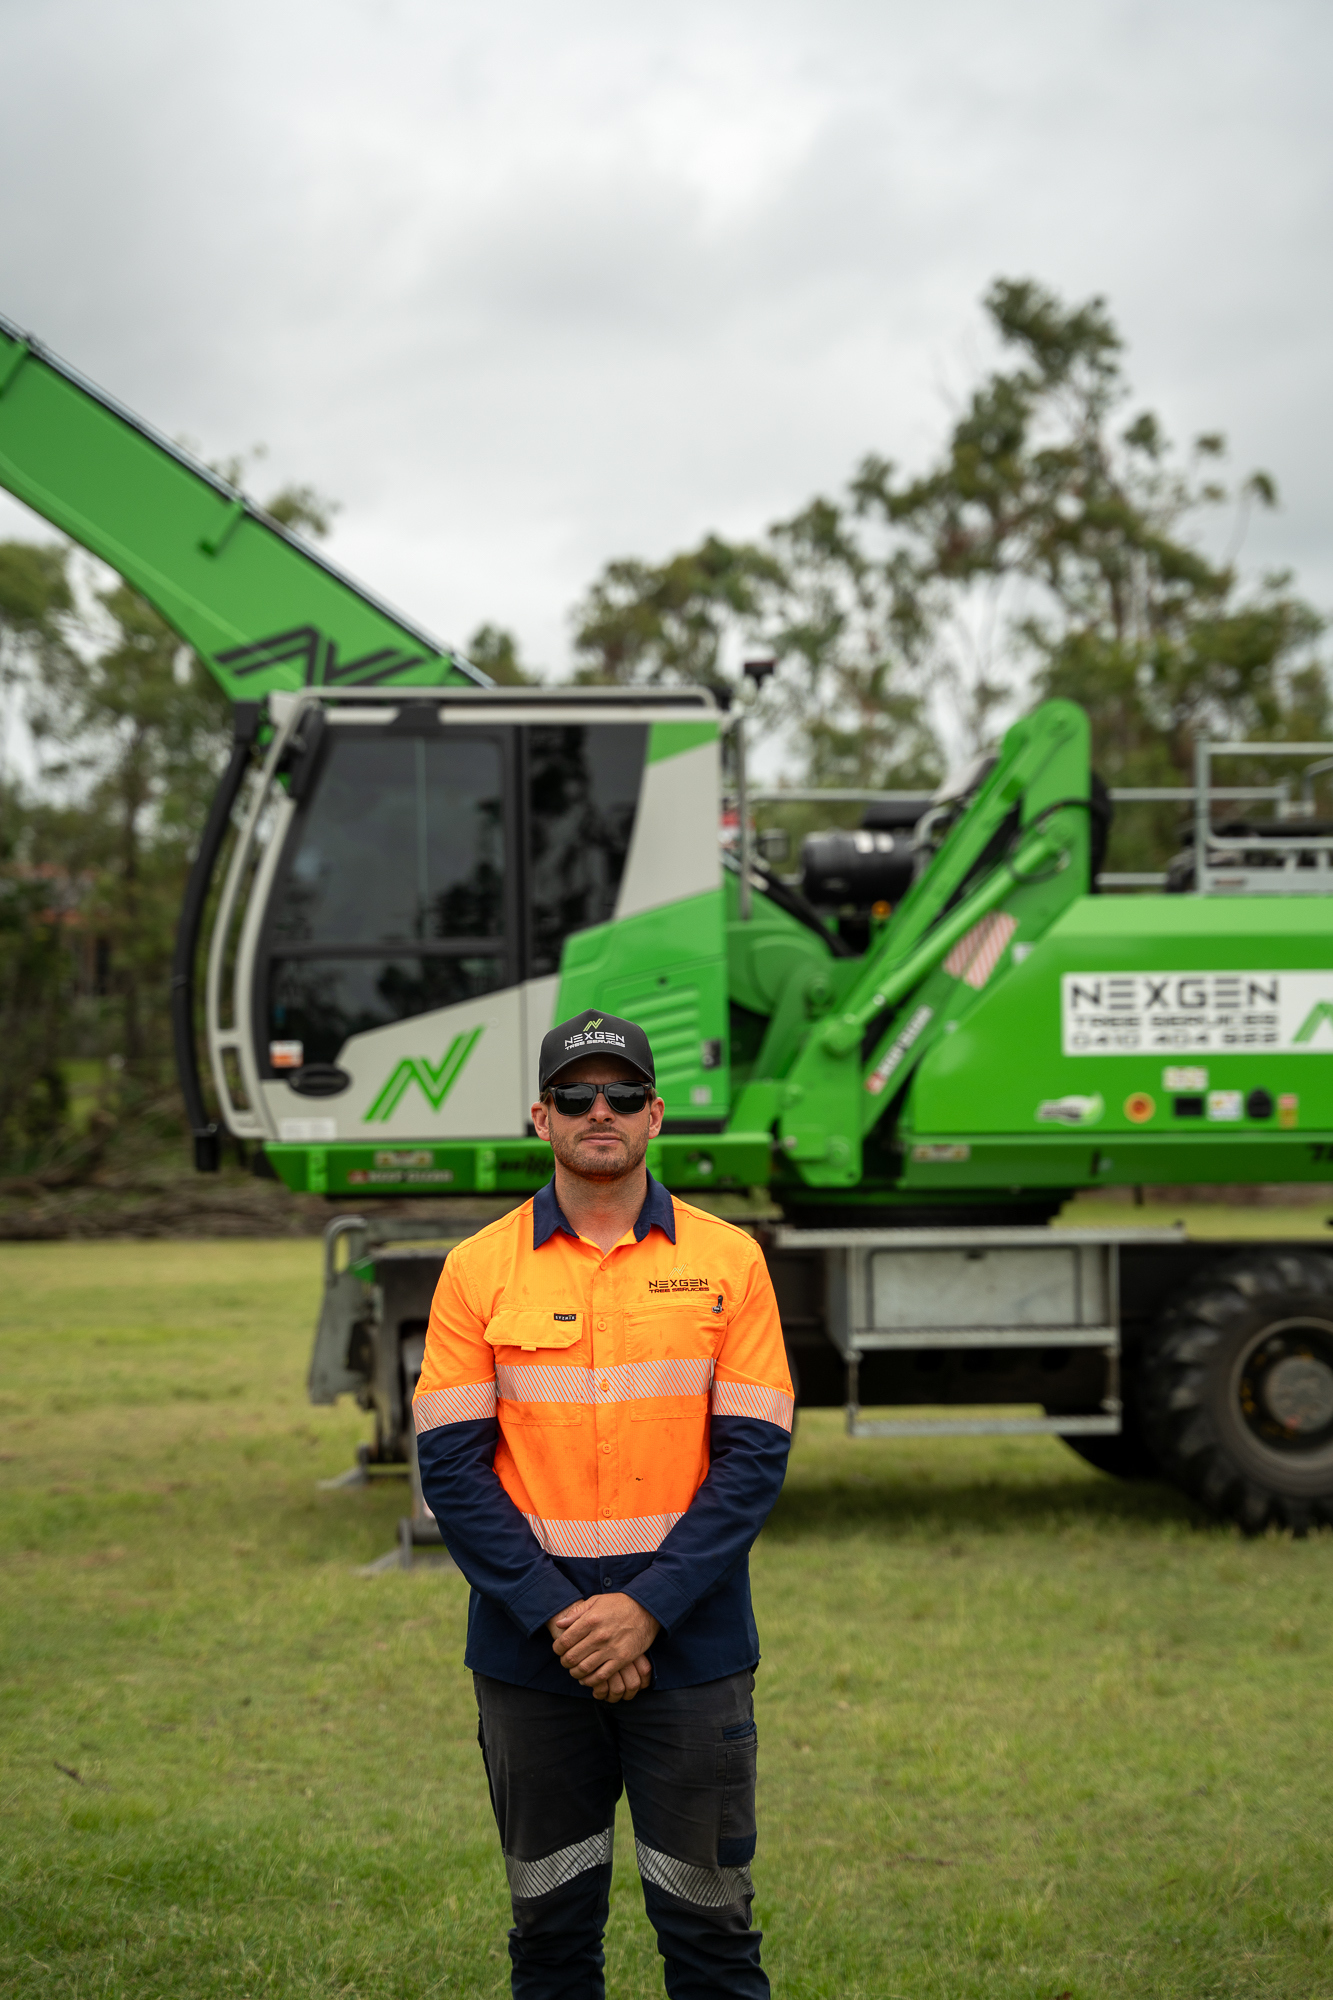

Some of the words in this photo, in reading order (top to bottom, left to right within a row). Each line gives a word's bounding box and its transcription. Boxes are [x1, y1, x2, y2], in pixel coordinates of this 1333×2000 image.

[1071, 976, 1278, 1010] NEXGEN
[1073, 1016, 1140, 1028] TREE
[1151, 1014, 1278, 1027] SERVICES
[564, 1040, 585, 1050] TREE
[586, 1039, 626, 1048] SERVICES
[565, 1031, 625, 1047] NEXGEN
[648, 1278, 709, 1288] NEXGEN
